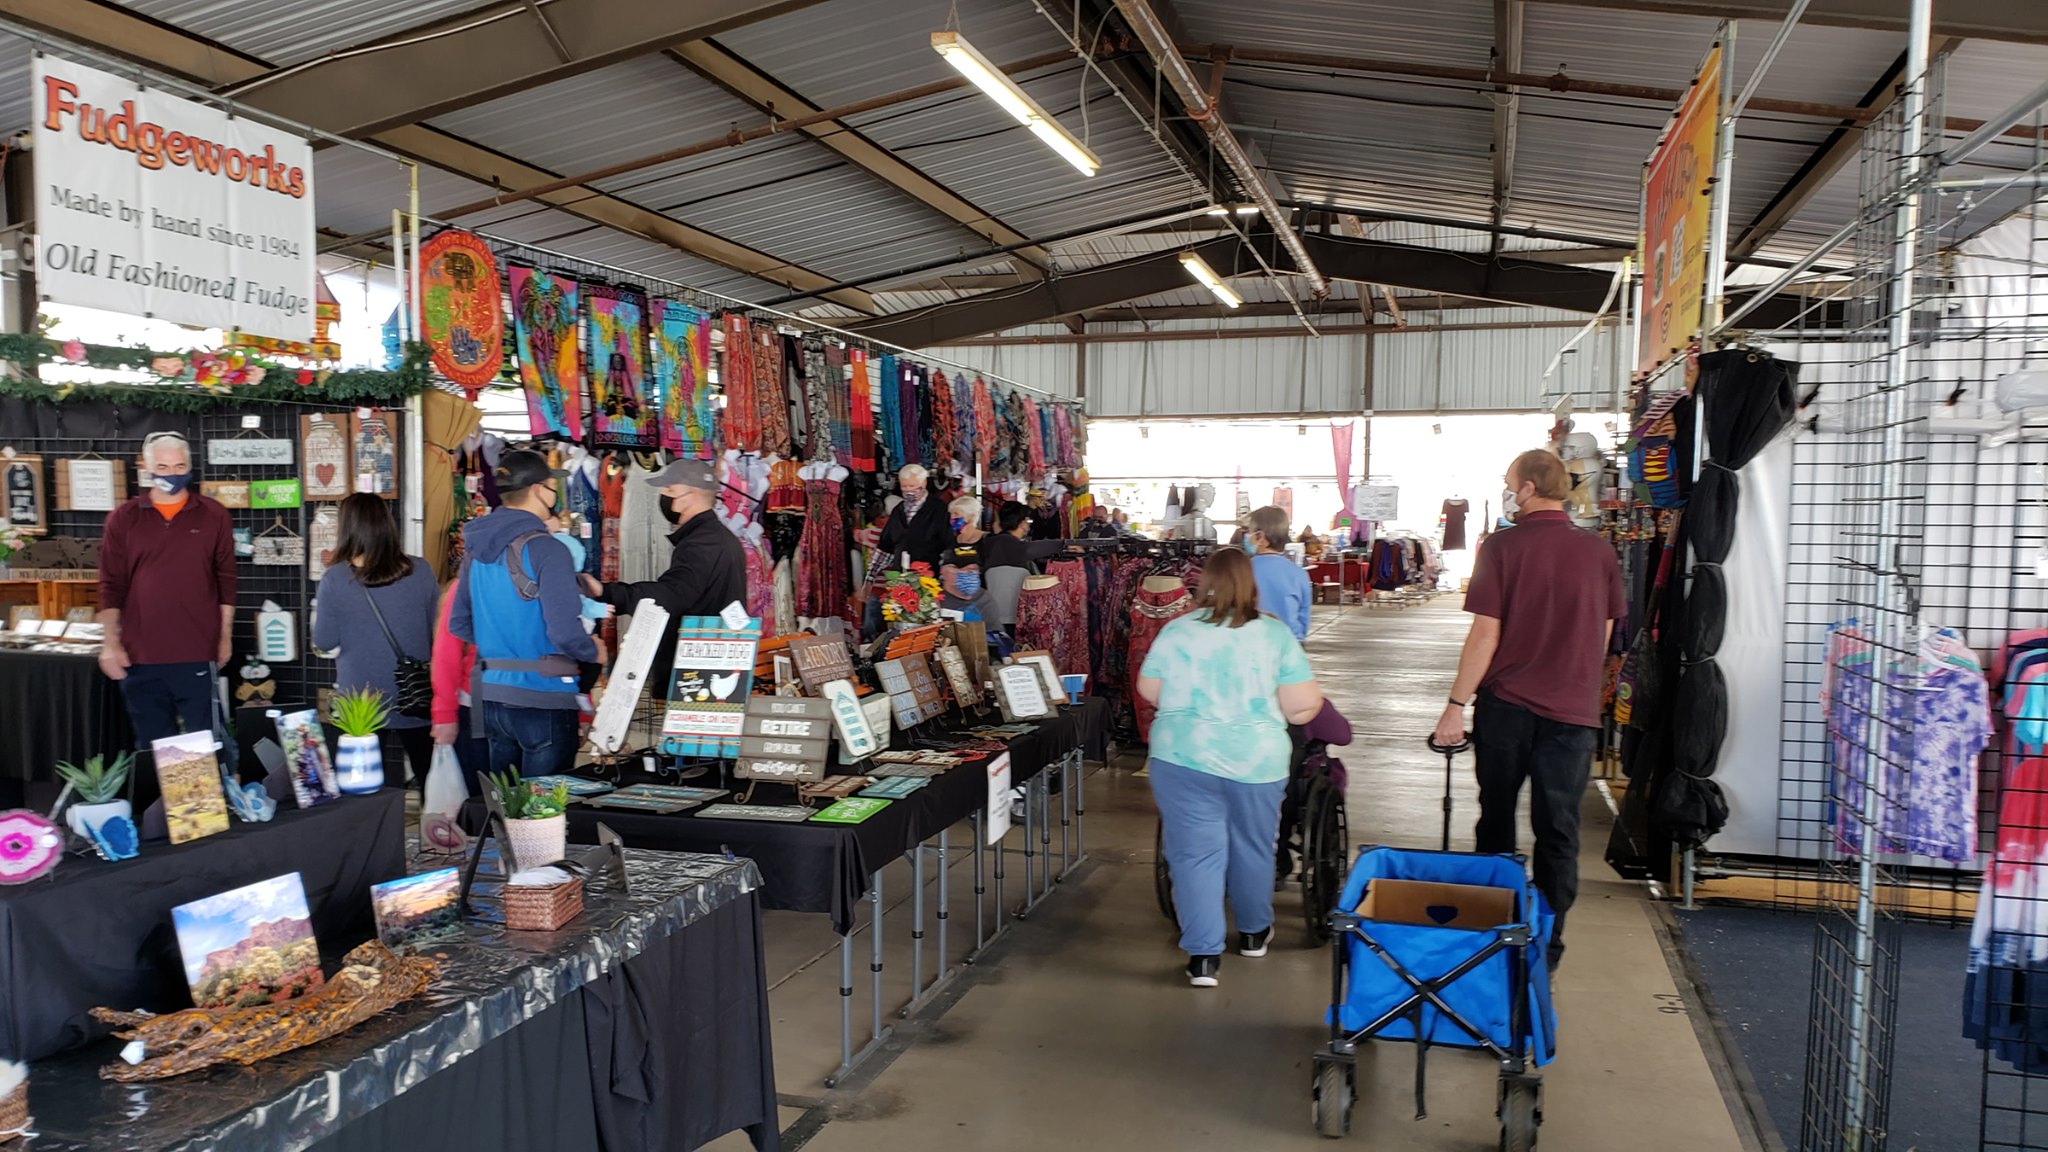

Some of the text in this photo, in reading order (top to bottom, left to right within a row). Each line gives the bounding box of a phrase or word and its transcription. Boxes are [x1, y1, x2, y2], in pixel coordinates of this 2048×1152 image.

[44, 74, 306, 200] Fudgeworks
[50, 184, 301, 261] Made by hand since 1984
[46, 242, 310, 318] Old Fashioned Fudge
